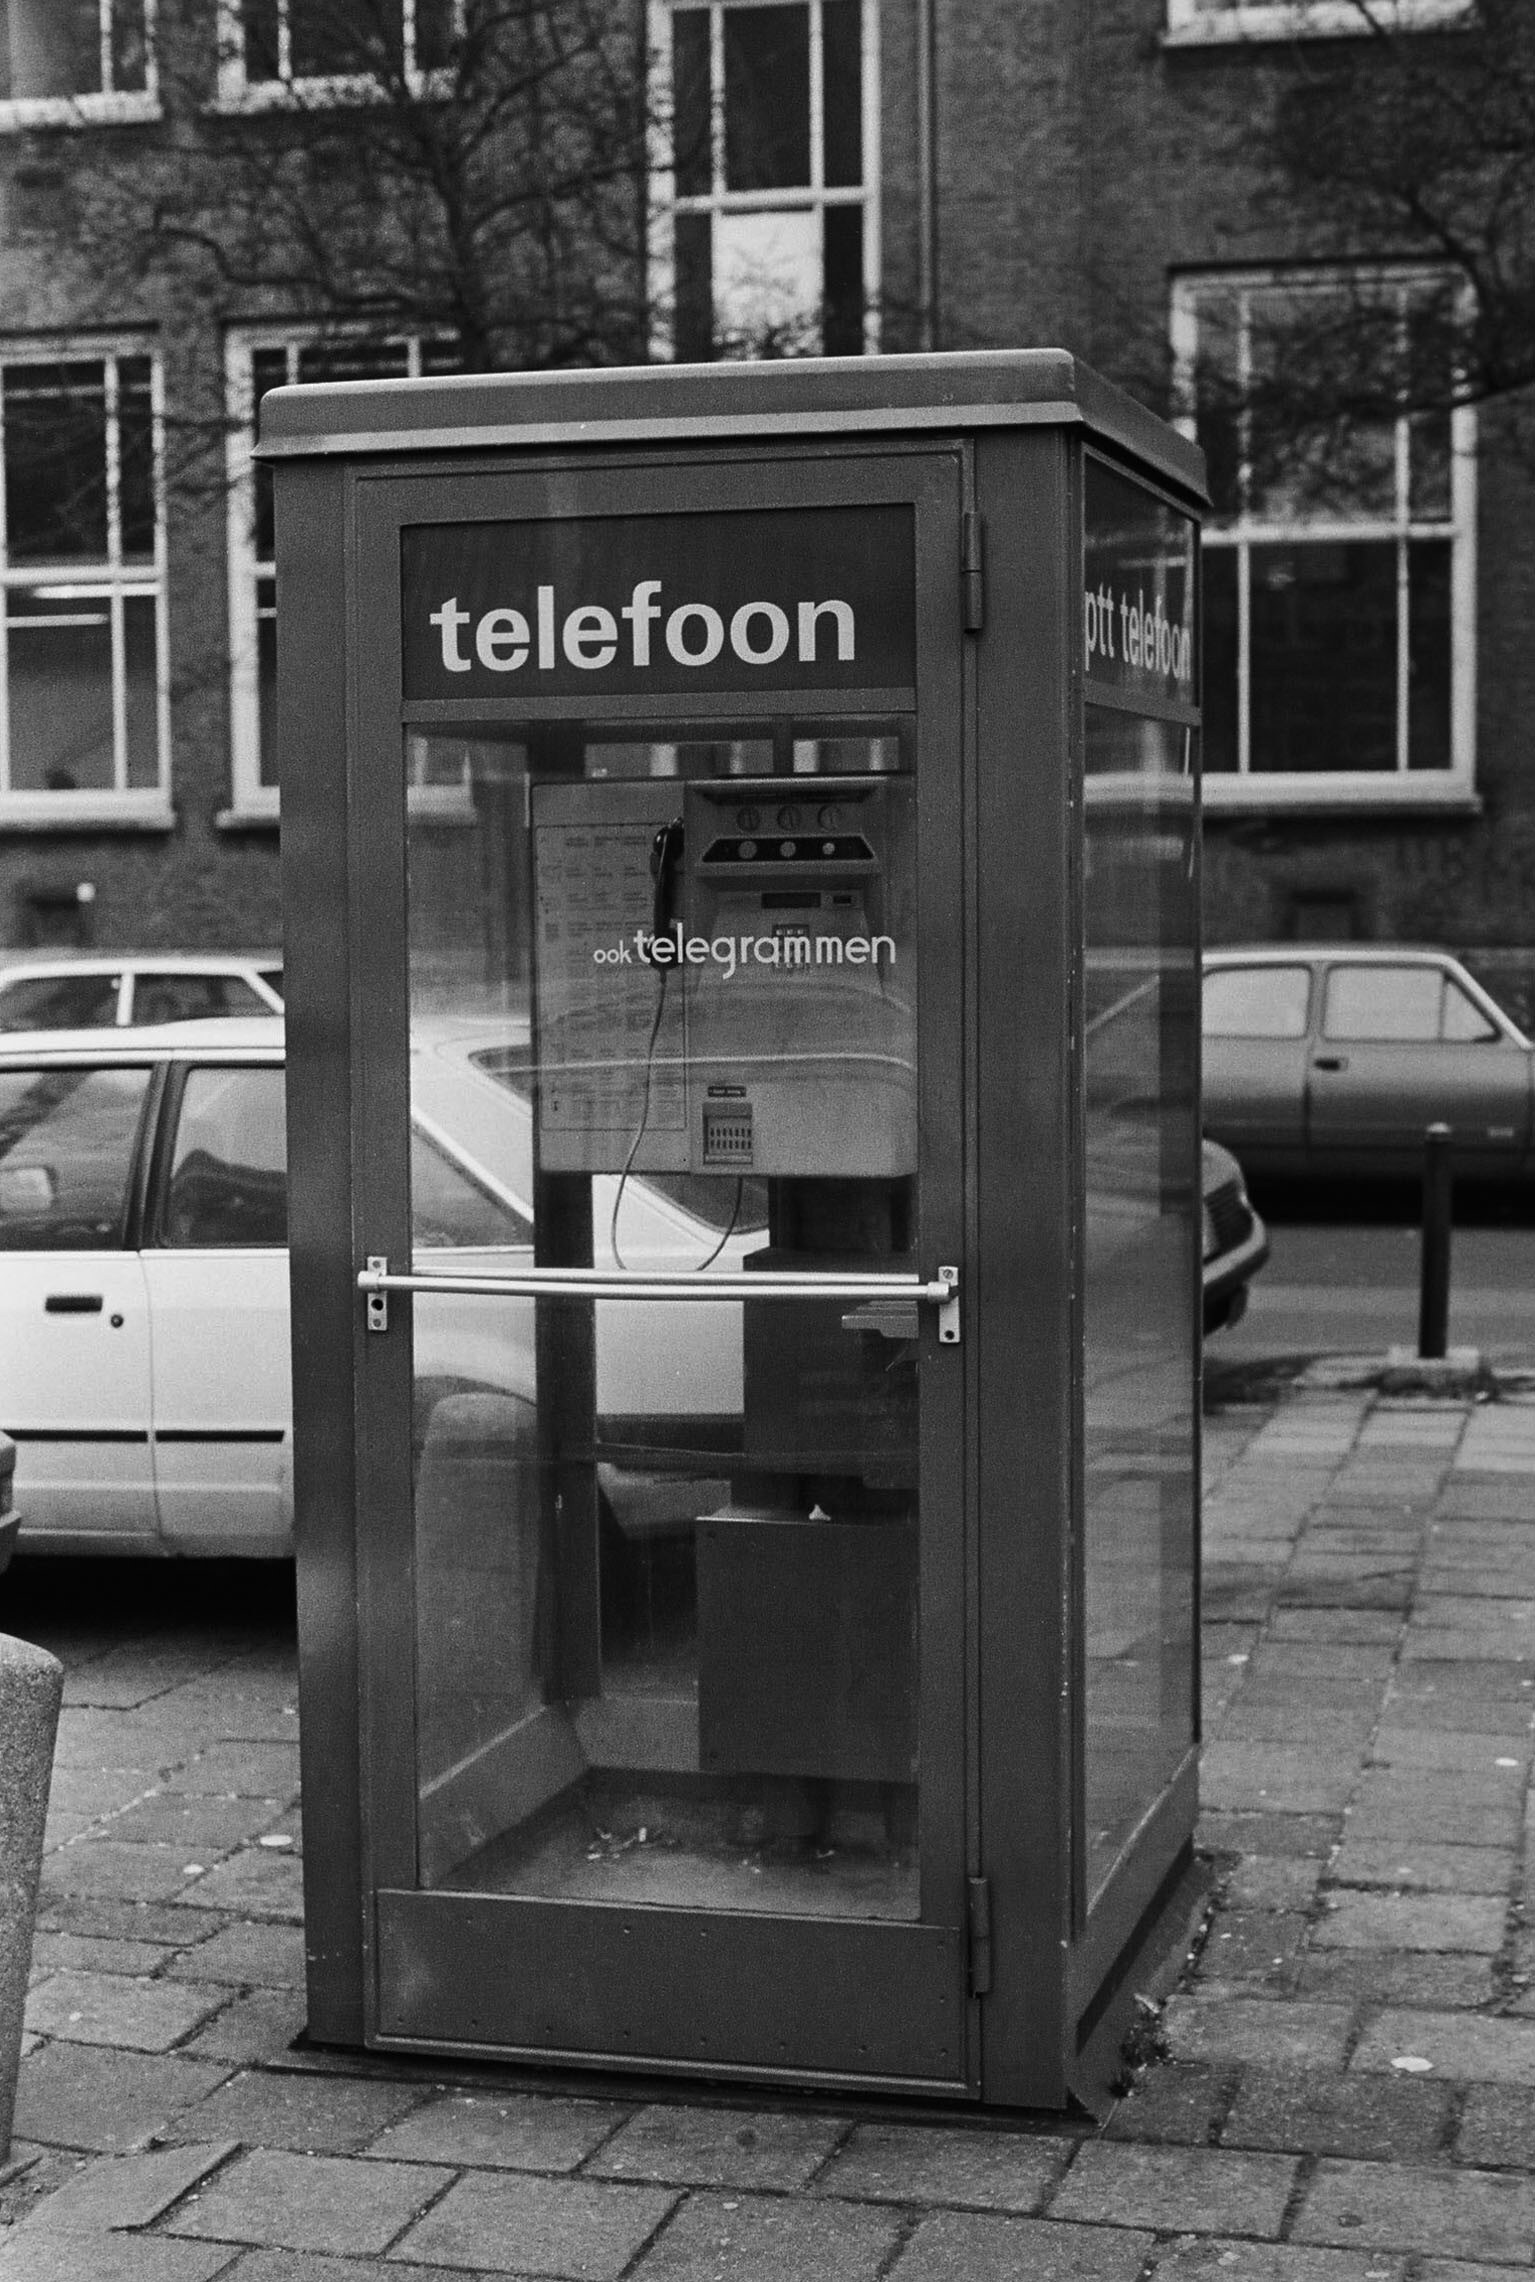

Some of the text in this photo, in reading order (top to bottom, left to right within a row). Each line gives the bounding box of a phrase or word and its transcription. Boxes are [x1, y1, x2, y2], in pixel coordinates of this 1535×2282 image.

[429, 580, 855, 673] telefoon
[1085, 582, 1191, 681] ptt telefoon
[593, 922, 896, 980] ook telegrammen
